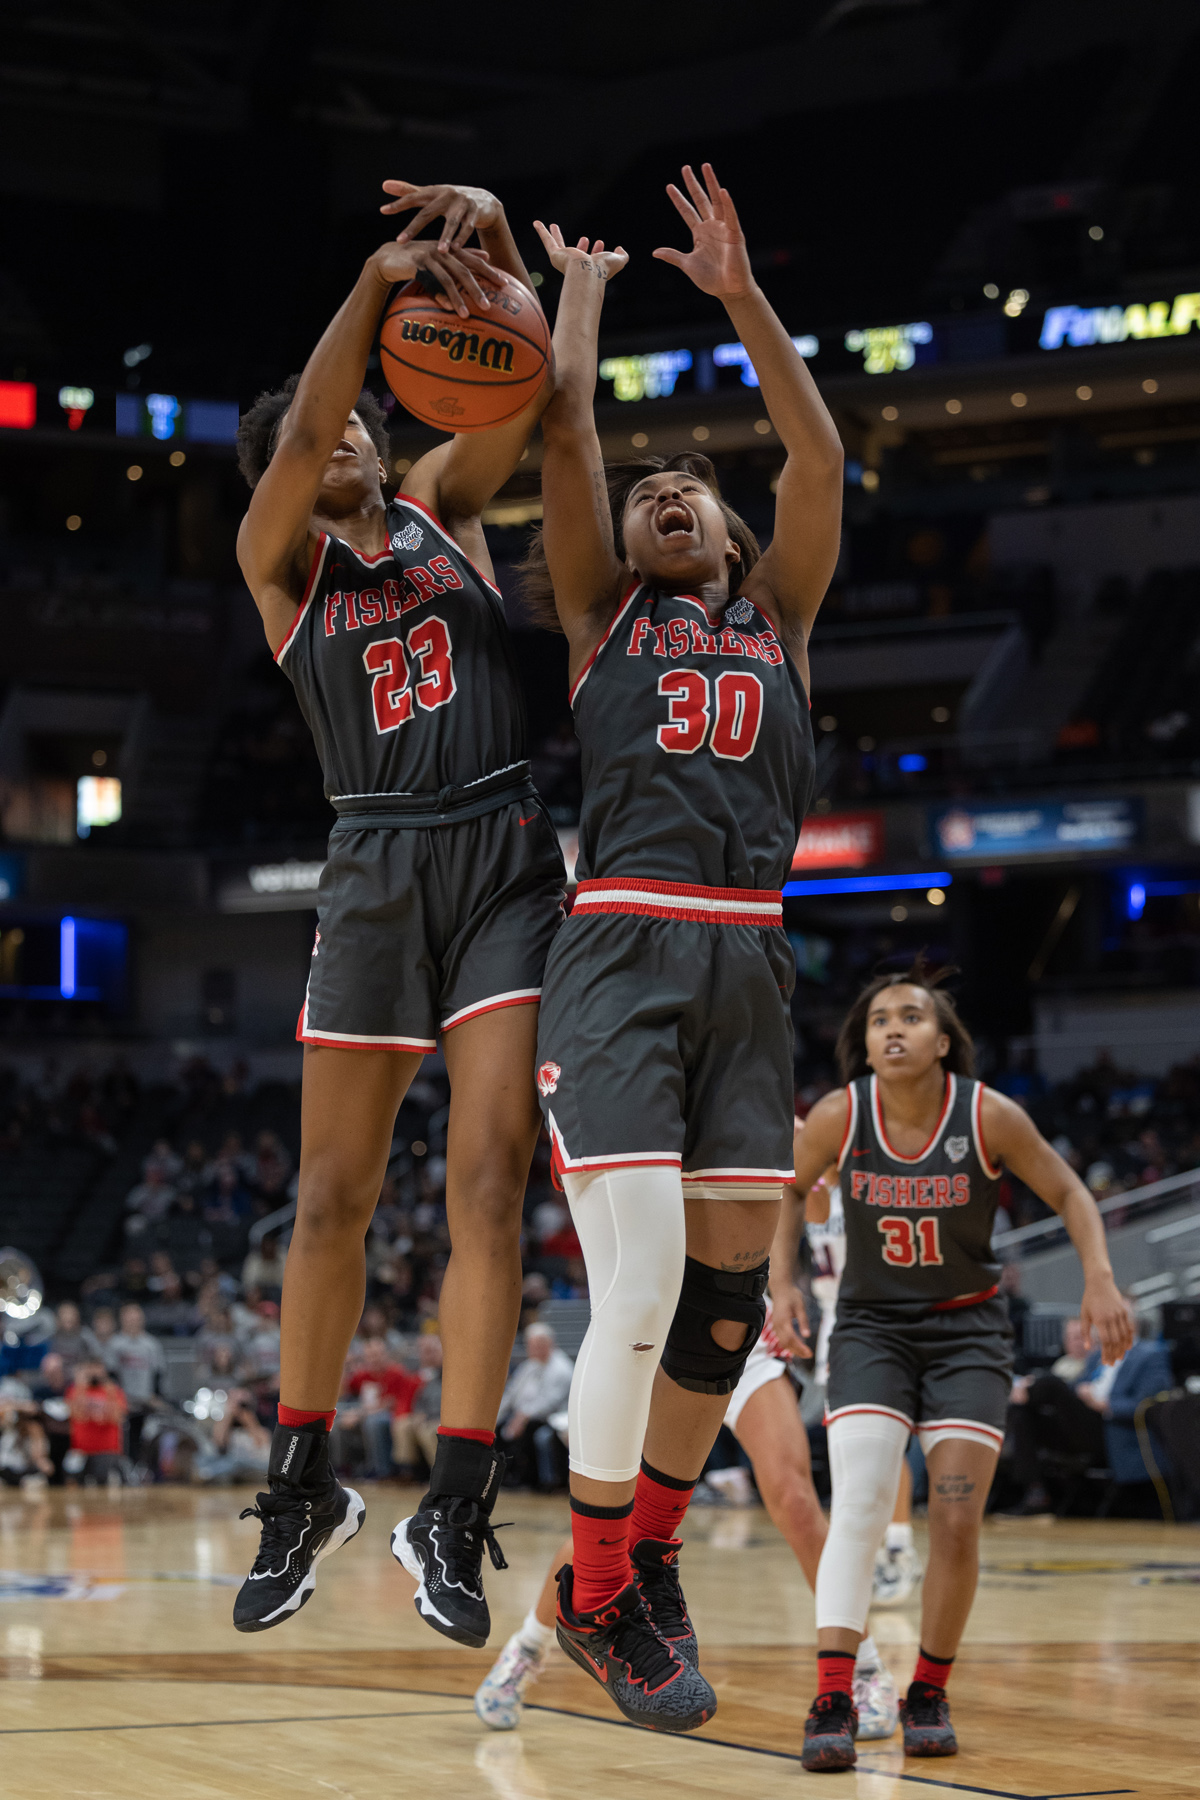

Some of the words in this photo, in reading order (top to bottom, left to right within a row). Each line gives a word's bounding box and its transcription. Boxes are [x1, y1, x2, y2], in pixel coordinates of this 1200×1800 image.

[401, 319, 515, 375] Wilson
[325, 554, 464, 637] FISHERS
[626, 617, 785, 666] FISHERS
[362, 615, 458, 735] 23
[656, 668, 764, 762] 30
[850, 1171, 971, 1208] FISHERS
[877, 1215, 944, 1268] 31
[281, 1435, 299, 1475] BODYPROX
[481, 1460, 498, 1500] BODYPROX
